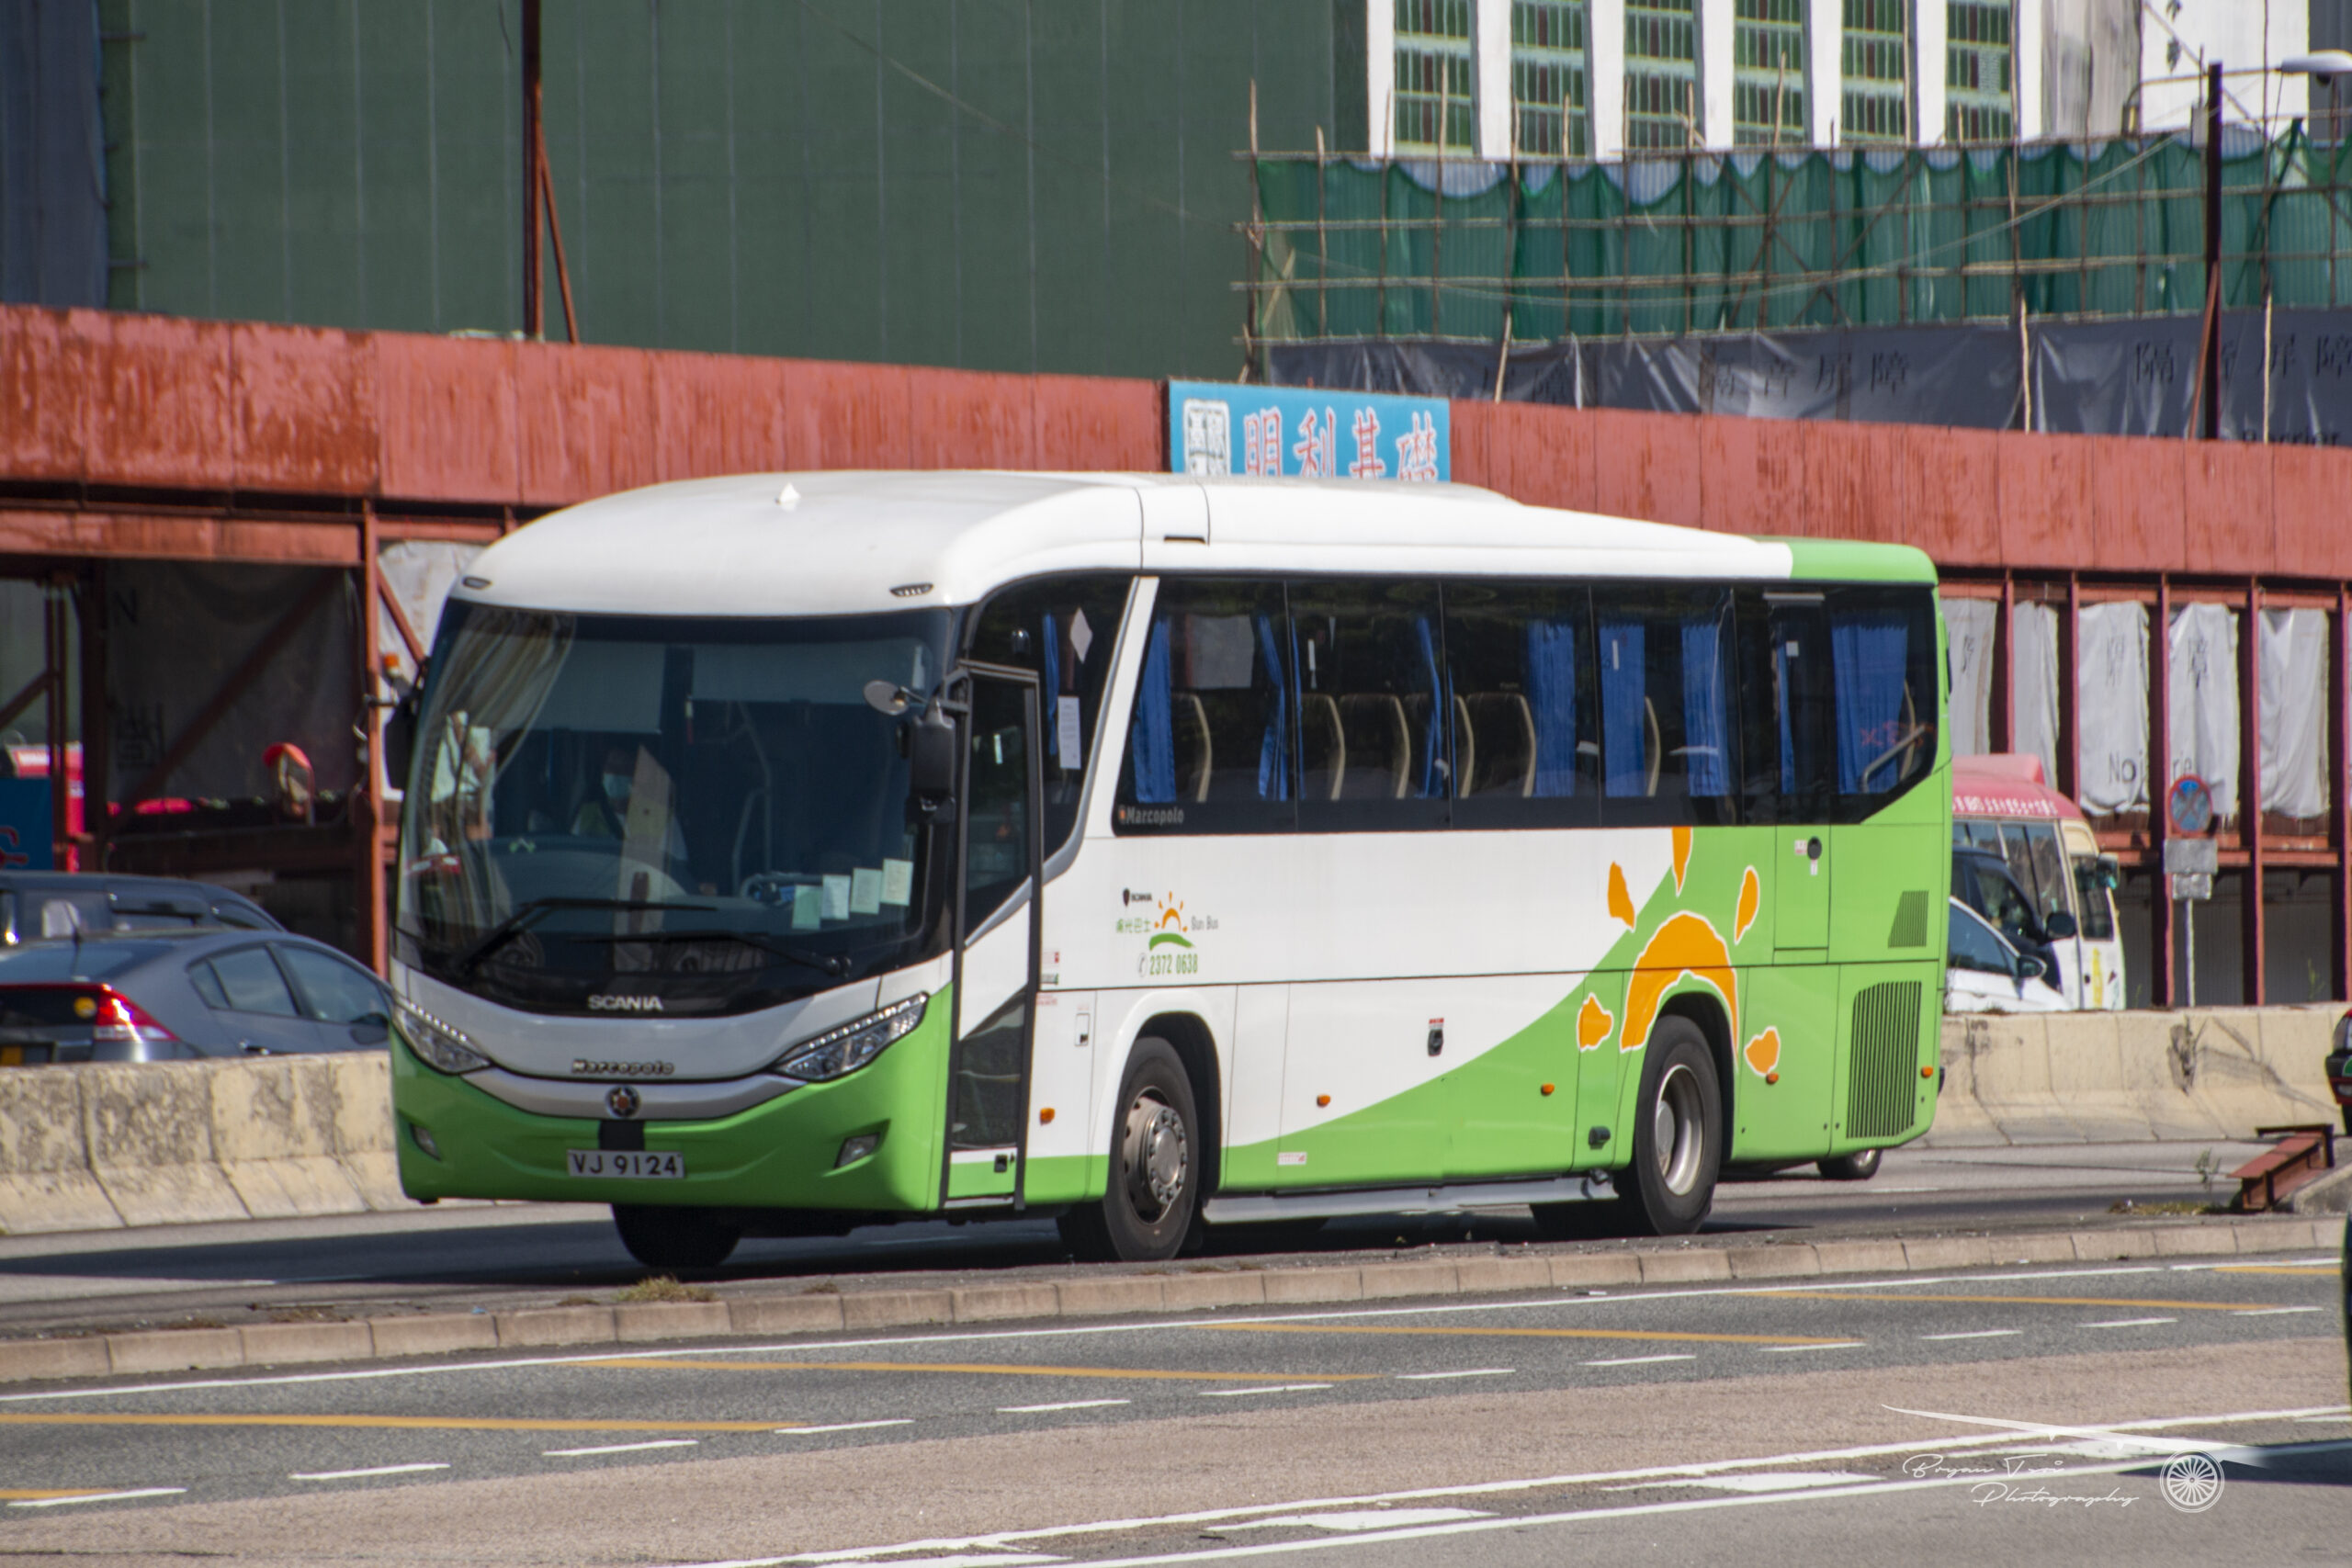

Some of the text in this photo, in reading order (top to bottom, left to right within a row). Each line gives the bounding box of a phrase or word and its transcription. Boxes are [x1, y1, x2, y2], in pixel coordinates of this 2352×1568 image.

[1125, 805, 1184, 826] Marcopolo
[1191, 914, 1219, 931] Sun Bus
[1149, 953, 1198, 976] 2372 0638
[587, 995, 663, 1011] SCANIA
[571, 1058, 676, 1076] Marcopolo
[572, 1153, 677, 1176] VJ 9124
